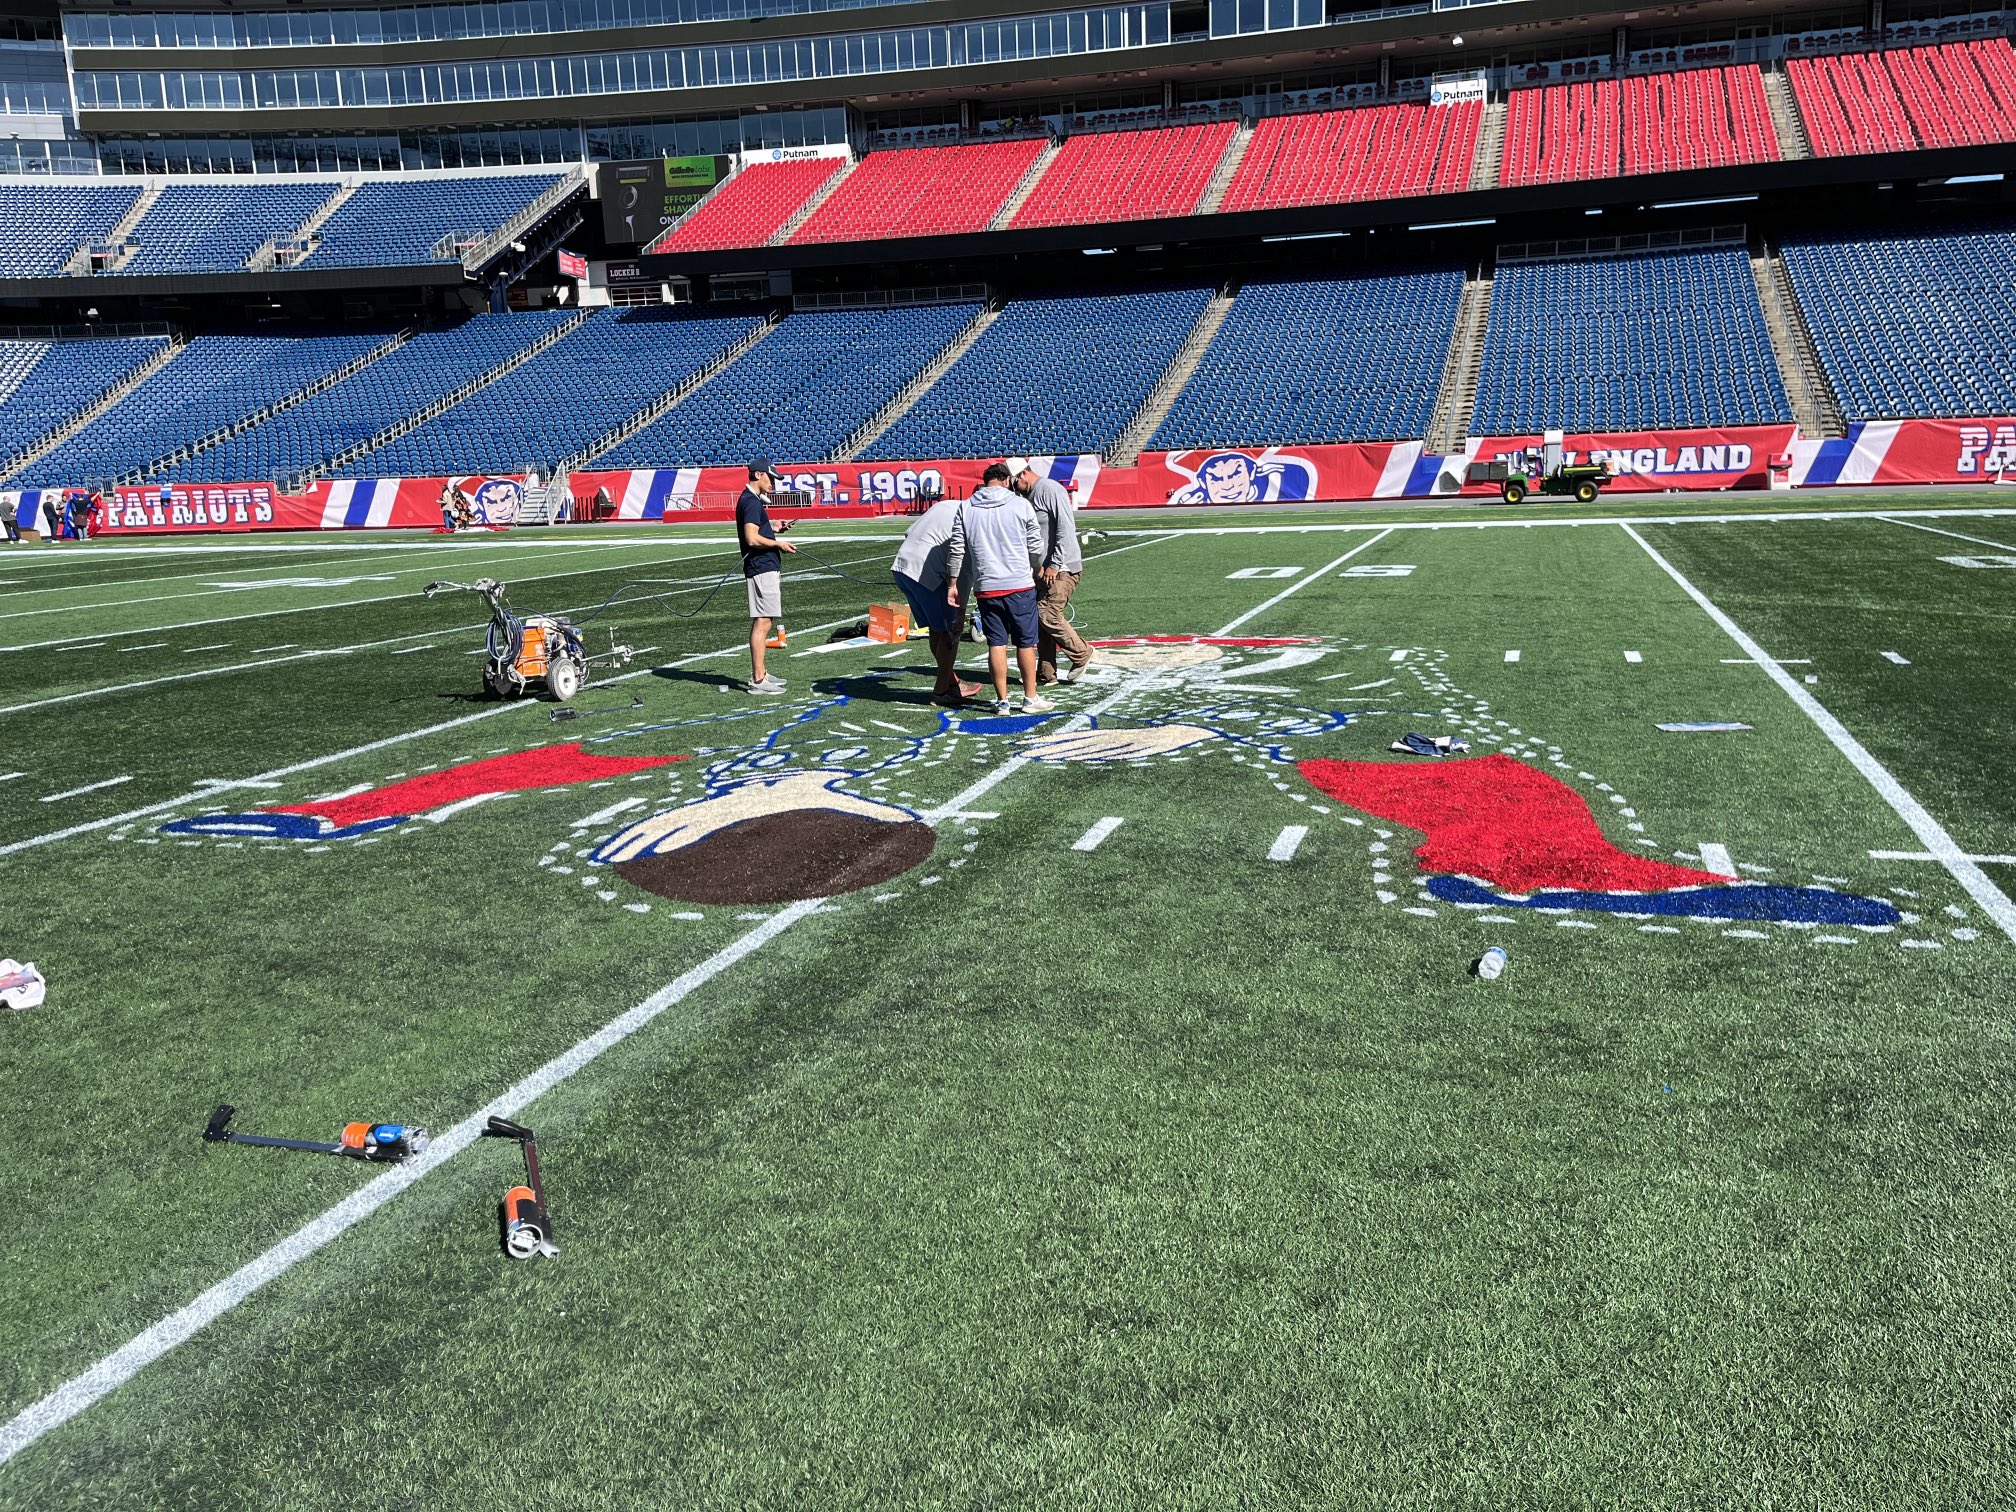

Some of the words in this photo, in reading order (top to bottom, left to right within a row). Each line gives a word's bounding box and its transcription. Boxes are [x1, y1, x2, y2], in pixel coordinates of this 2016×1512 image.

[1443, 90, 1483, 100] Putnam
[783, 150, 818, 158] Putnam
[663, 205, 691, 215] SHAV
[610, 268, 635, 277] LOCKER
[774, 472, 849, 503] EST.
[859, 469, 944, 502] 1960
[107, 487, 273, 527] PATRIOTS
